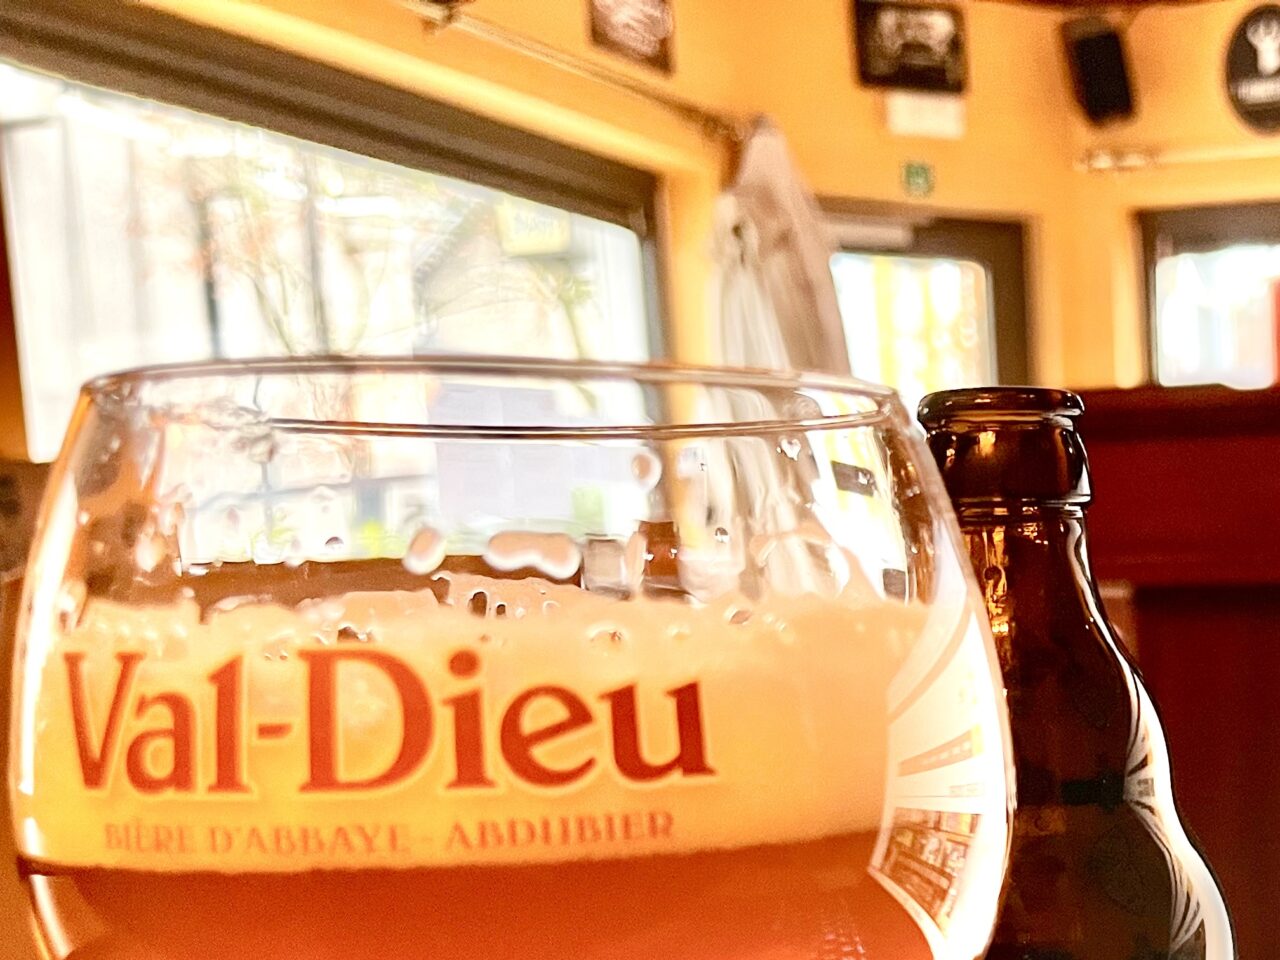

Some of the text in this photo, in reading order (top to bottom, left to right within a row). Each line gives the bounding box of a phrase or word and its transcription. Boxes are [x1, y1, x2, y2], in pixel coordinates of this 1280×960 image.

[64, 648, 718, 795] Val-Dieu
[104, 815, 194, 855] BIÈRE
[209, 822, 411, 857] D'ABBAYE
